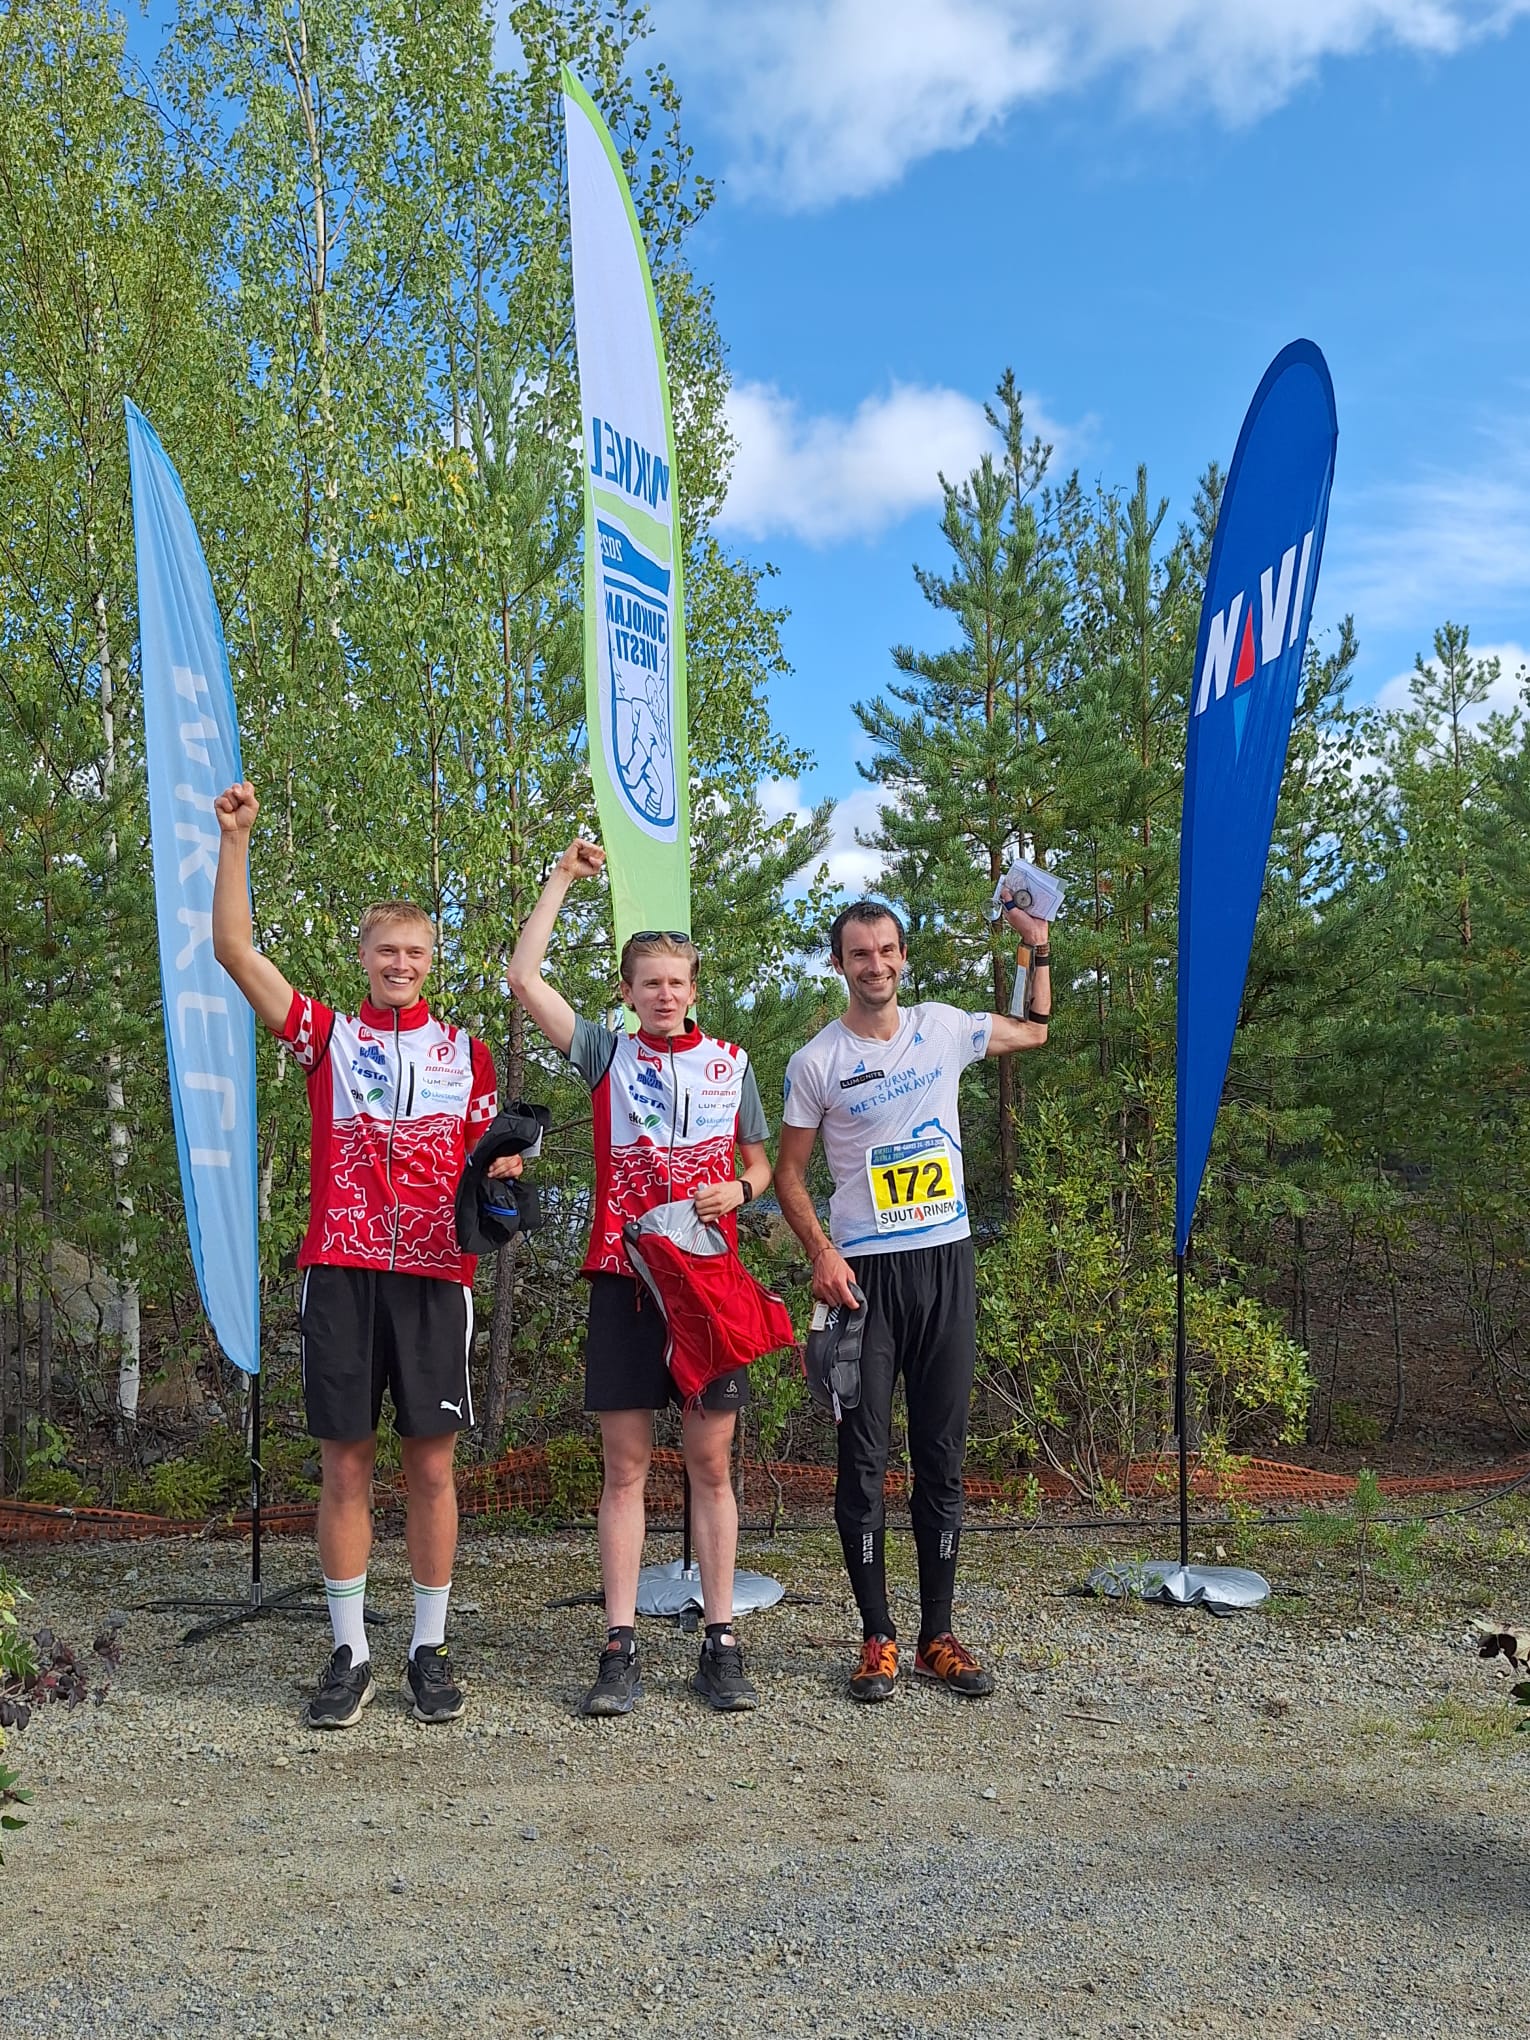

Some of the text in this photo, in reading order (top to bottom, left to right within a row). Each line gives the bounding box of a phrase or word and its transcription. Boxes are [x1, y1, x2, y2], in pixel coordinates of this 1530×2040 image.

[436, 1046, 449, 1061] P
[714, 1063, 727, 1080] P
[882, 1162, 947, 1204] 172
[880, 1200, 957, 1224] SUUTARINEN
